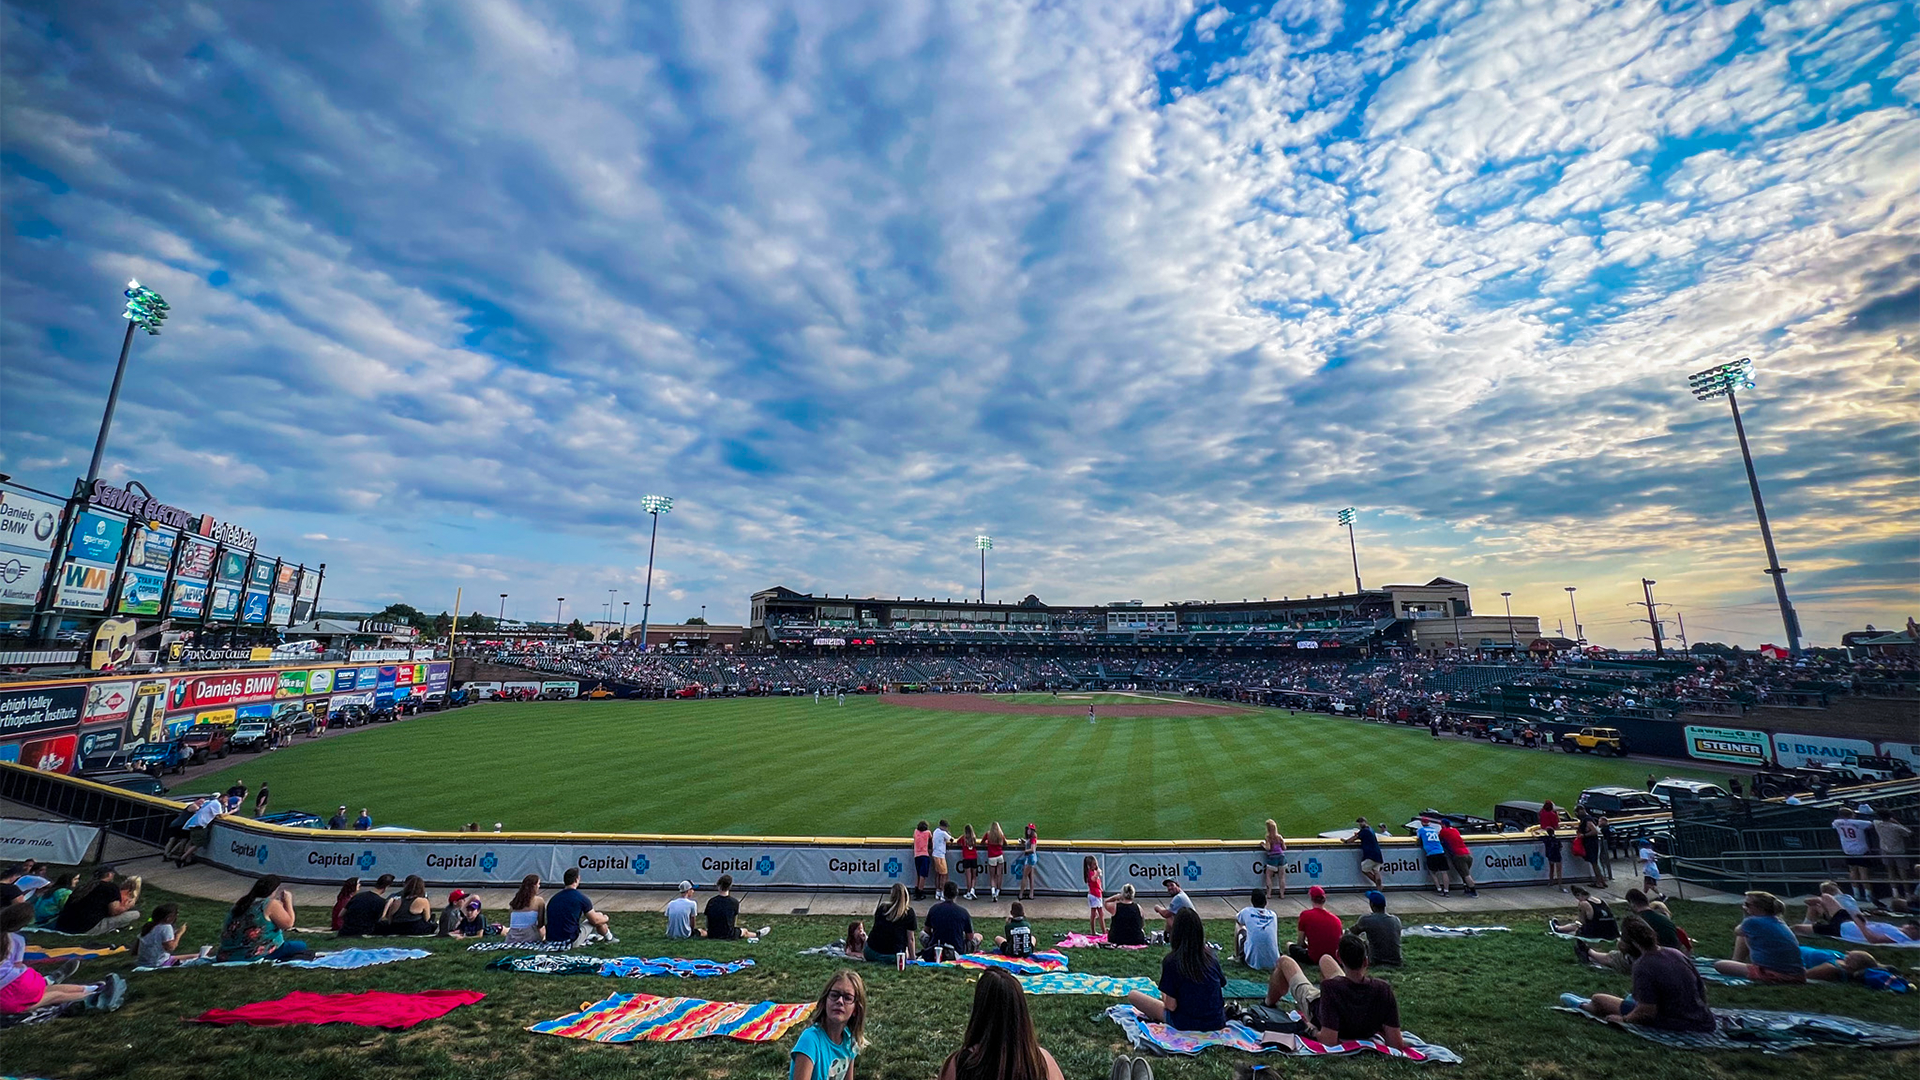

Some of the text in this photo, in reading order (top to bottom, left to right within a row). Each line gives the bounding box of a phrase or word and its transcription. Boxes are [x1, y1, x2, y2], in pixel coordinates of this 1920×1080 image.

[1, 503, 35, 521] Daniels
[1, 520, 28, 535] BMW
[210, 519, 256, 549] PenTeleData
[65, 564, 107, 591] WM
[2, 589, 35, 600] Allentown
[138, 586, 159, 594] COPIERS
[184, 586, 204, 602] NEWS
[225, 650, 250, 659] COLLEGE
[196, 676, 276, 699] Daniels BMW
[279, 678, 305, 688] Mike Ike
[28, 695, 53, 711] Valley
[0, 707, 77, 728] rthopedic Institute
[1702, 740, 1761, 754] STEINER
[1777, 742, 1858, 758] B BRAUN
[0, 837, 54, 847] extra mile.
[1426, 831, 1440, 842] 20
[231, 840, 257, 858] Capital
[308, 851, 355, 868] Capital
[426, 853, 478, 871] Capital
[578, 855, 628, 873] Capital
[702, 857, 753, 874] Capital
[829, 859, 881, 876] Capital
[1380, 859, 1420, 874] apital
[1485, 854, 1527, 870] Capital
[956, 860, 1007, 877] Cpil
[1129, 863, 1181, 880] Capital
